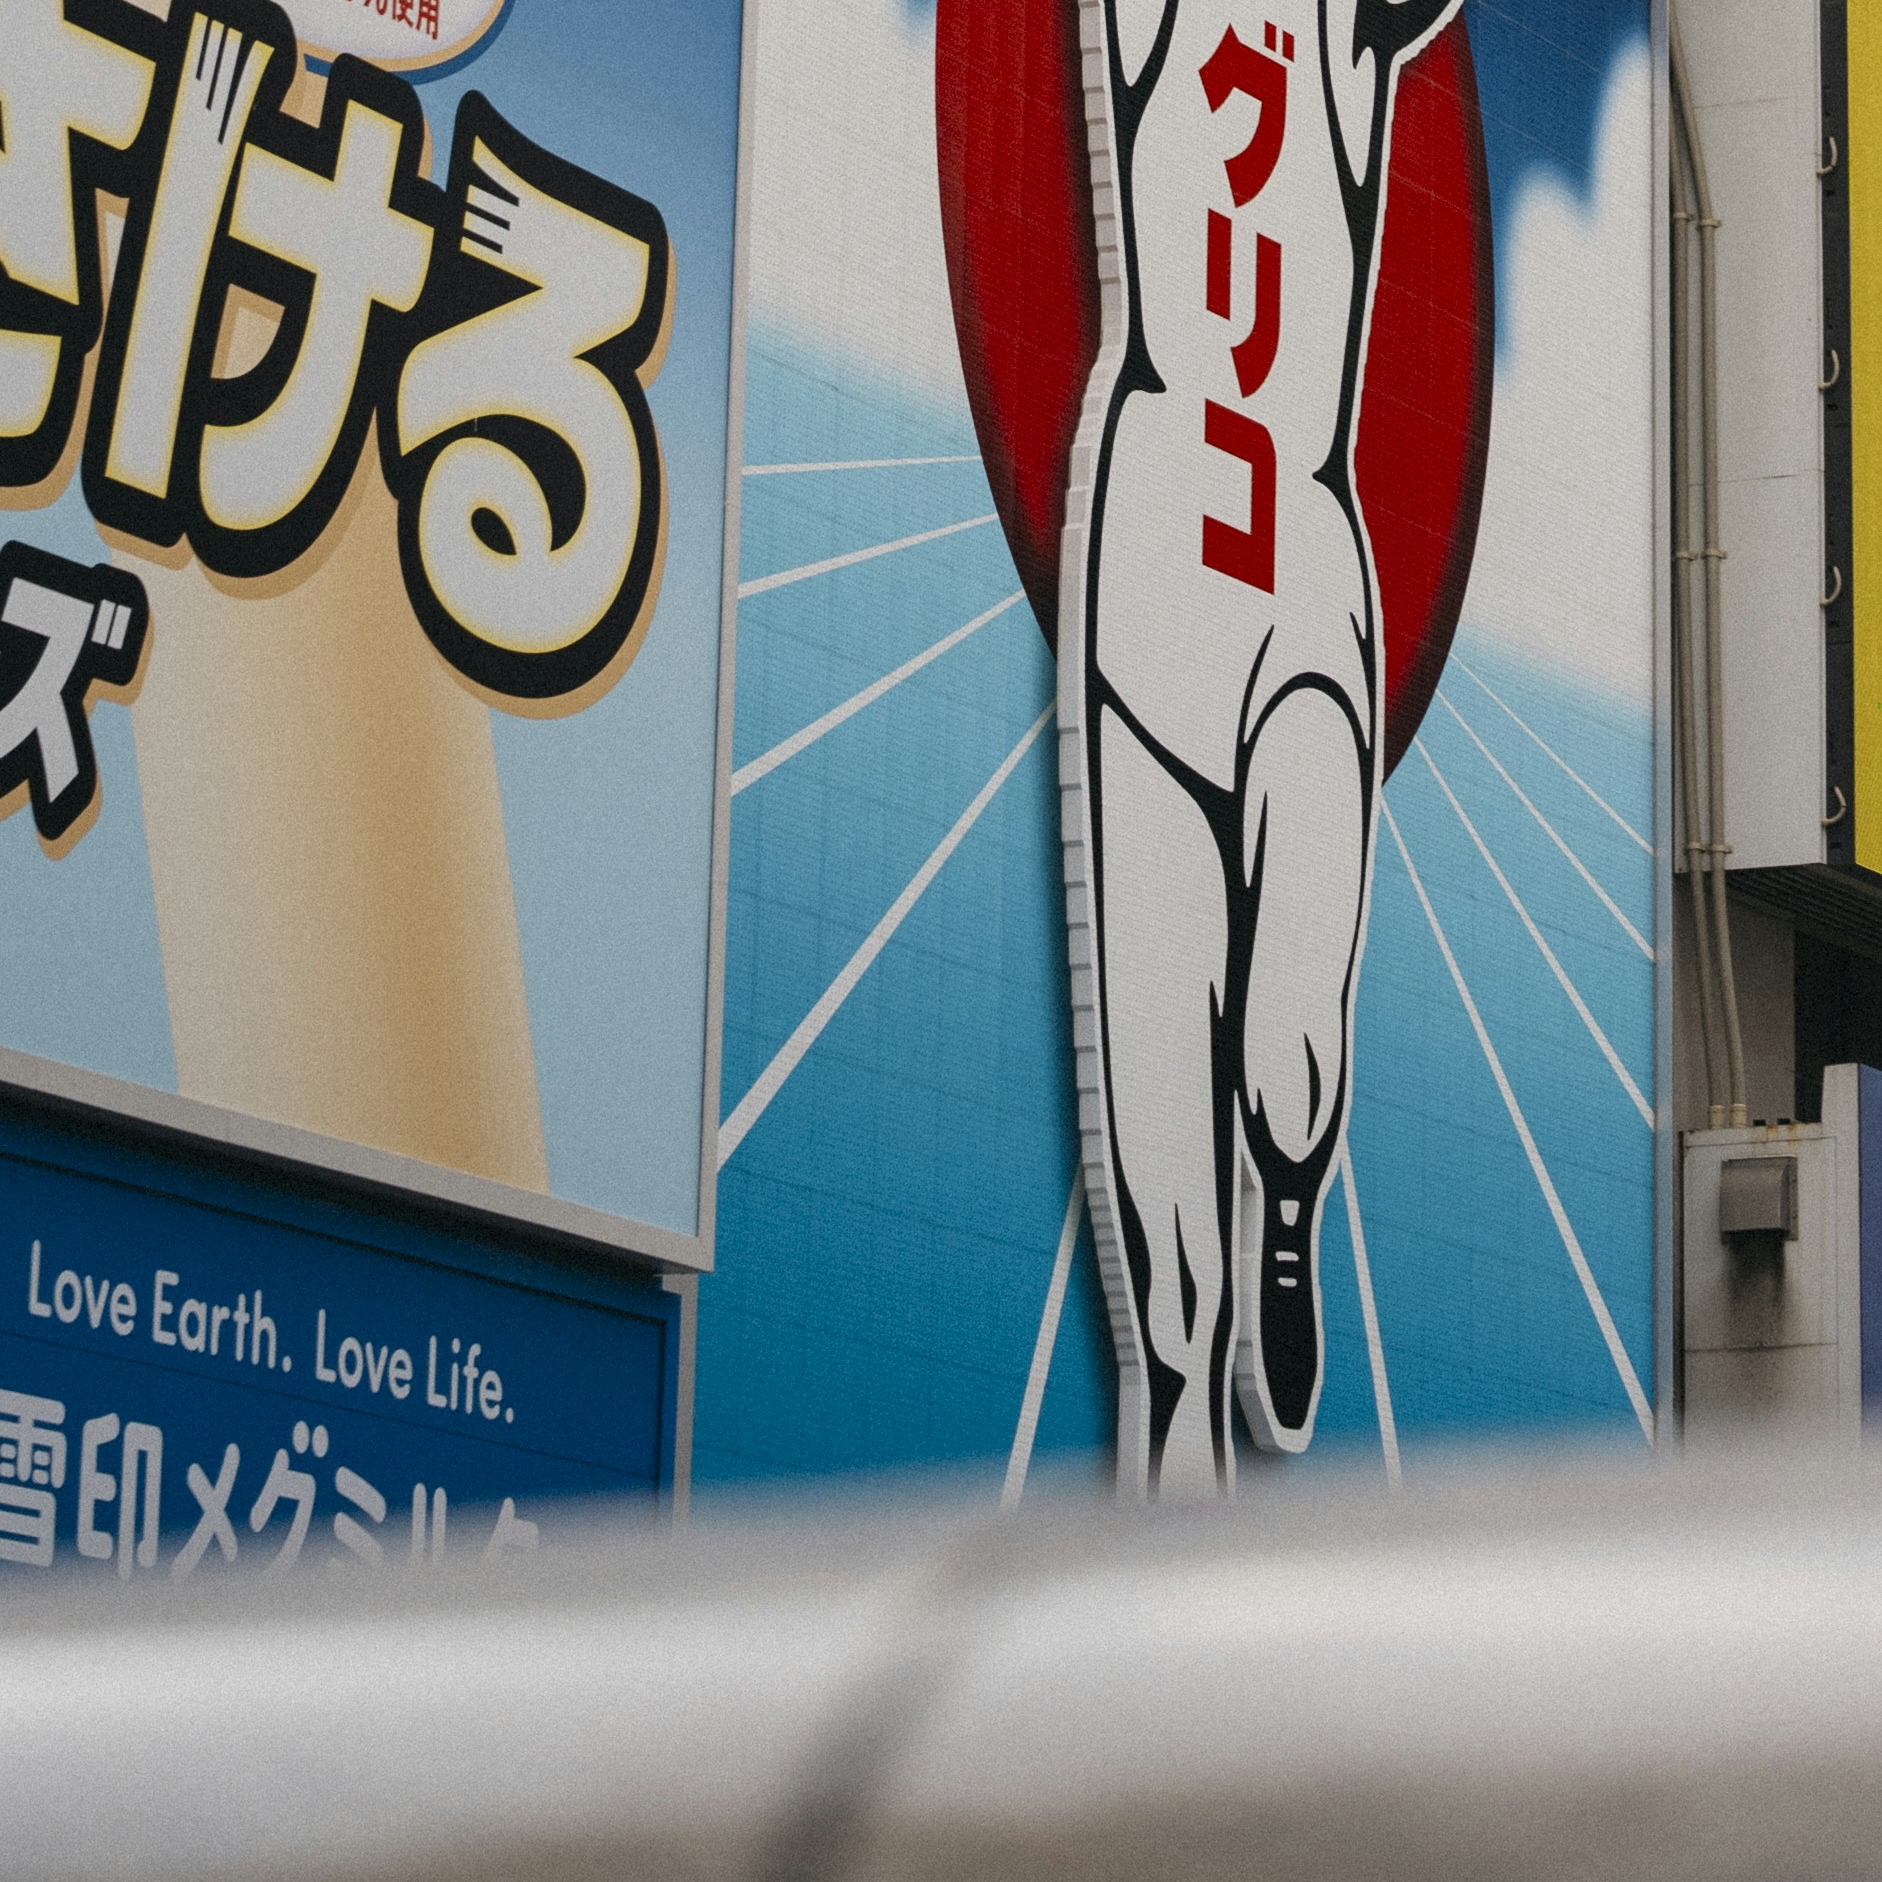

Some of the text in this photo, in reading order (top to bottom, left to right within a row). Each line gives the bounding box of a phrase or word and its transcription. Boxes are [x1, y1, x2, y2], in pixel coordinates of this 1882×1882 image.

[1199, 20, 1296, 597] グリコ
[27, 1239, 516, 1424] Love Earth. Love Life.
